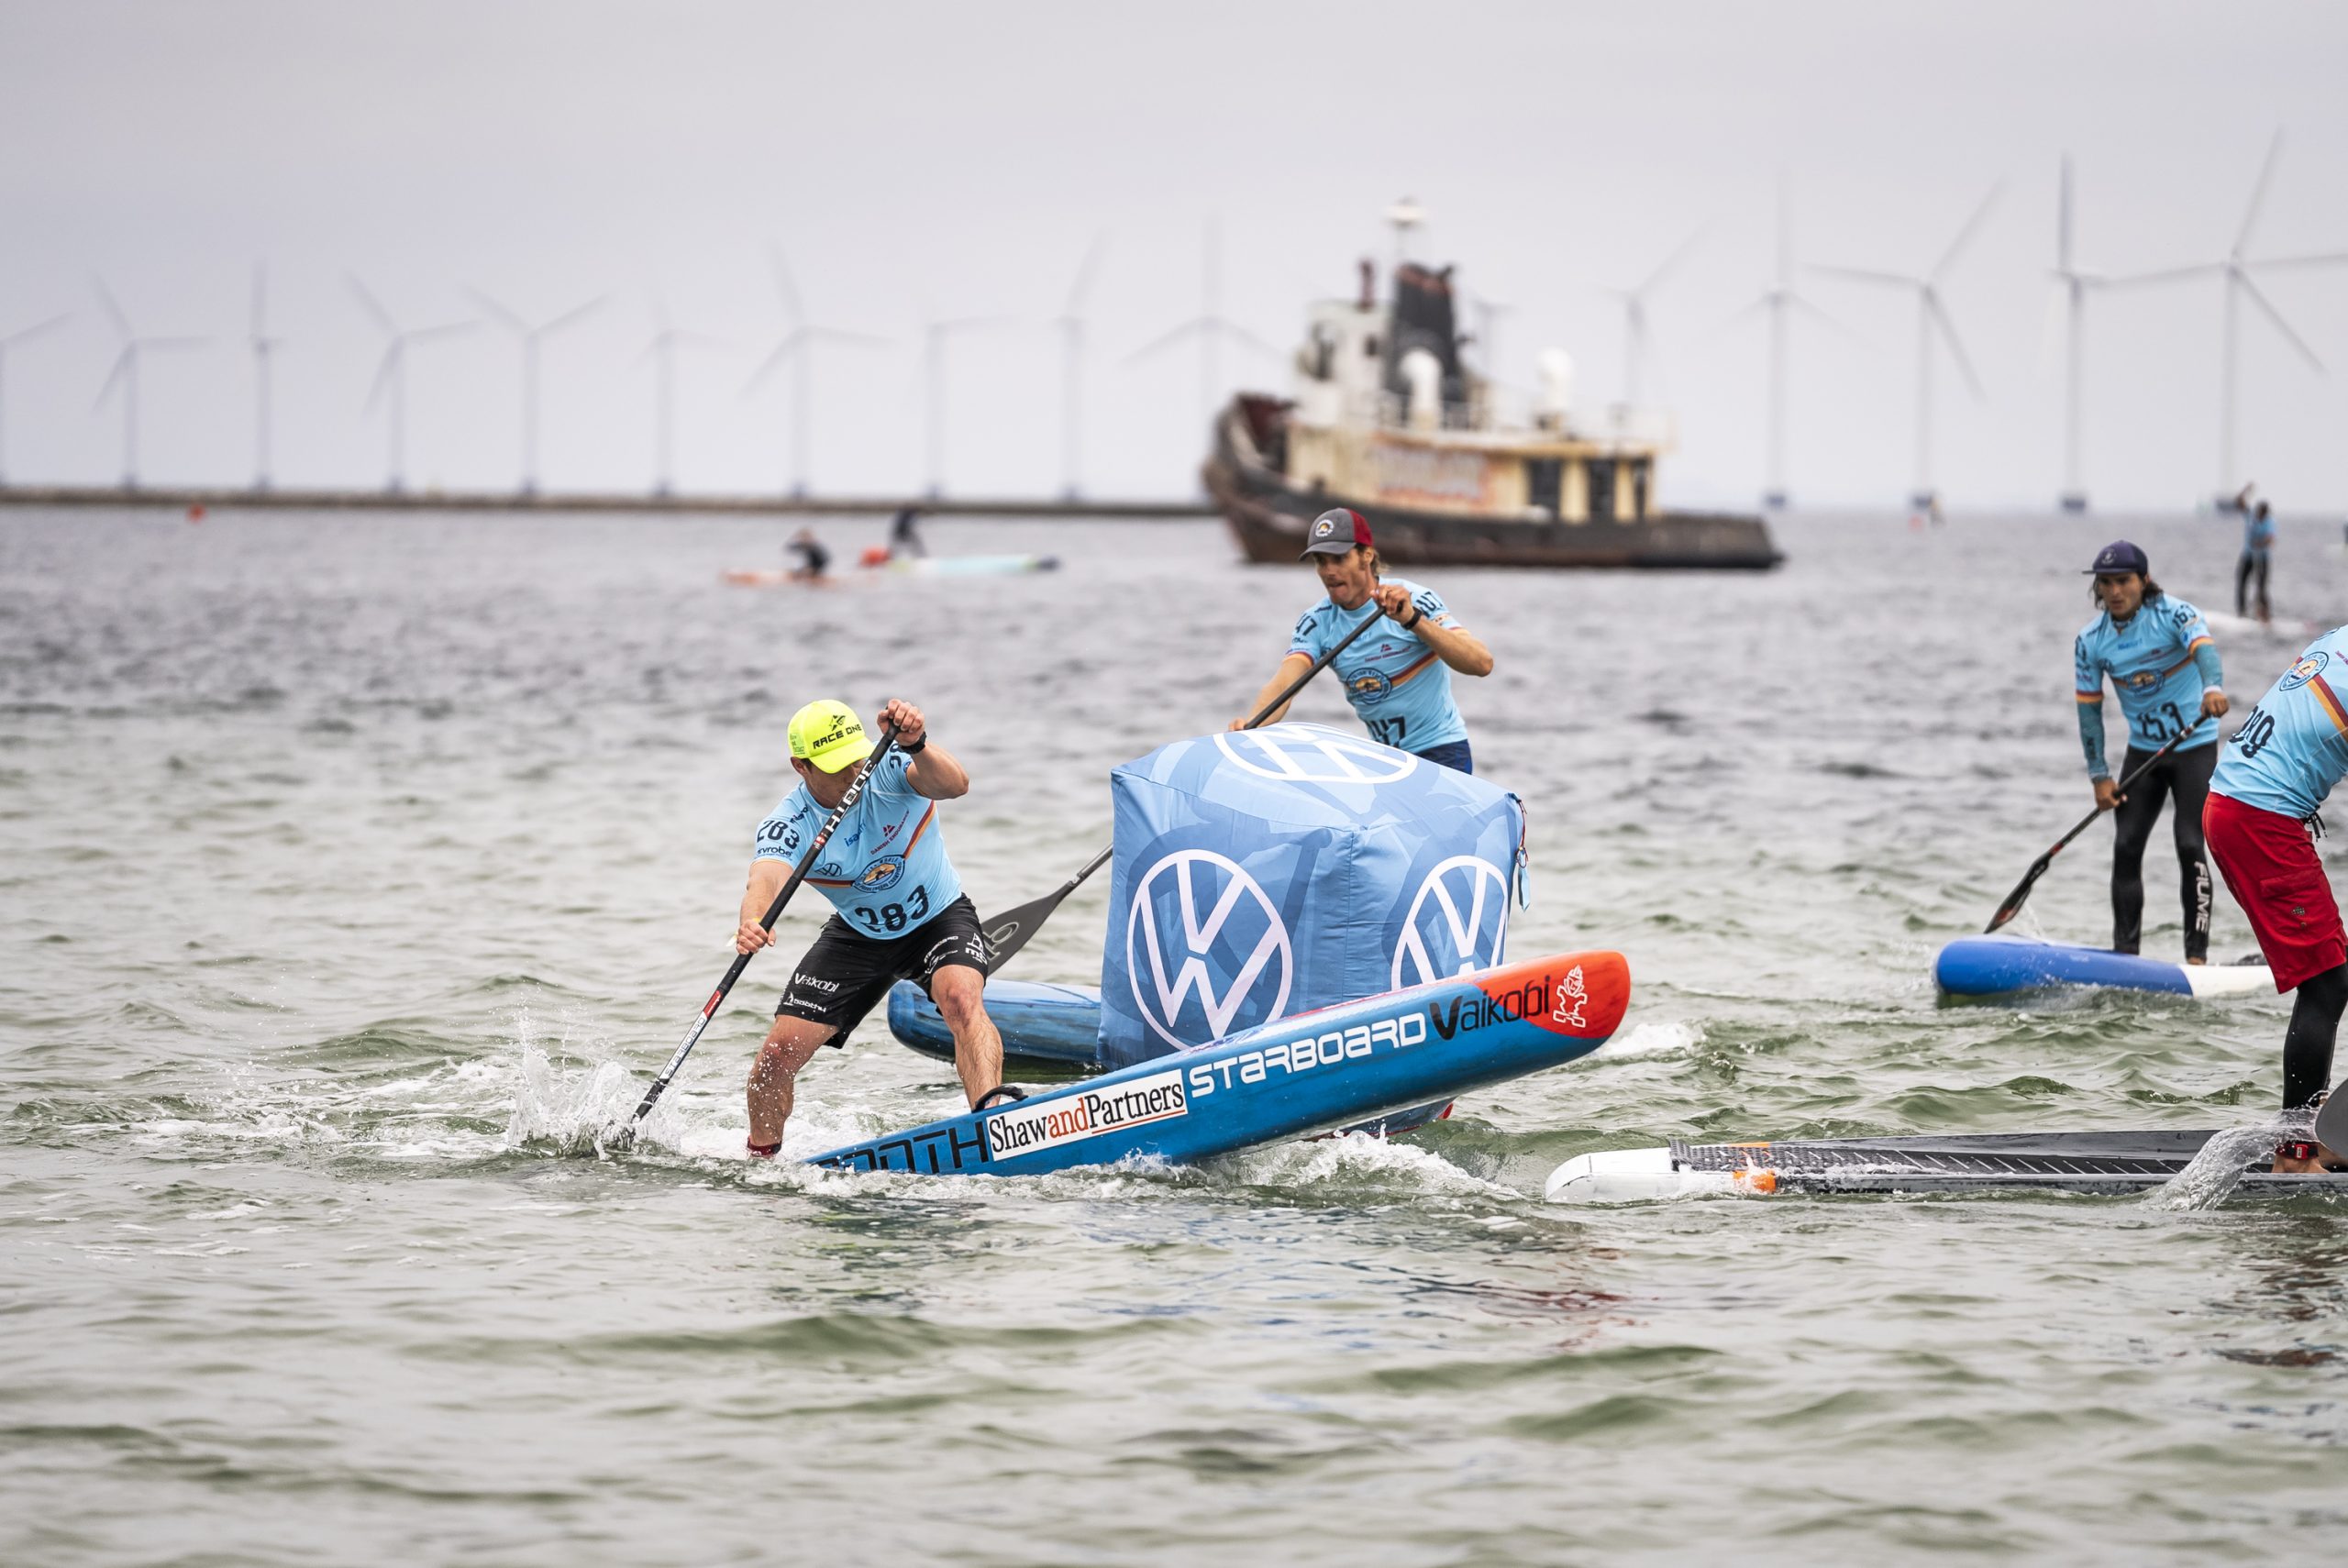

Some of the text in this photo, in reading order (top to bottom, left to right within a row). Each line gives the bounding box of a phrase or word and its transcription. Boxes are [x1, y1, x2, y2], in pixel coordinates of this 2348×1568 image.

[813, 730, 844, 749] RACE
[846, 723, 862, 735] ONE
[757, 820, 800, 849] 283
[854, 885, 929, 933] 283
[794, 972, 840, 992] Vaikobi
[1429, 975, 1551, 1042] Vaikobi
